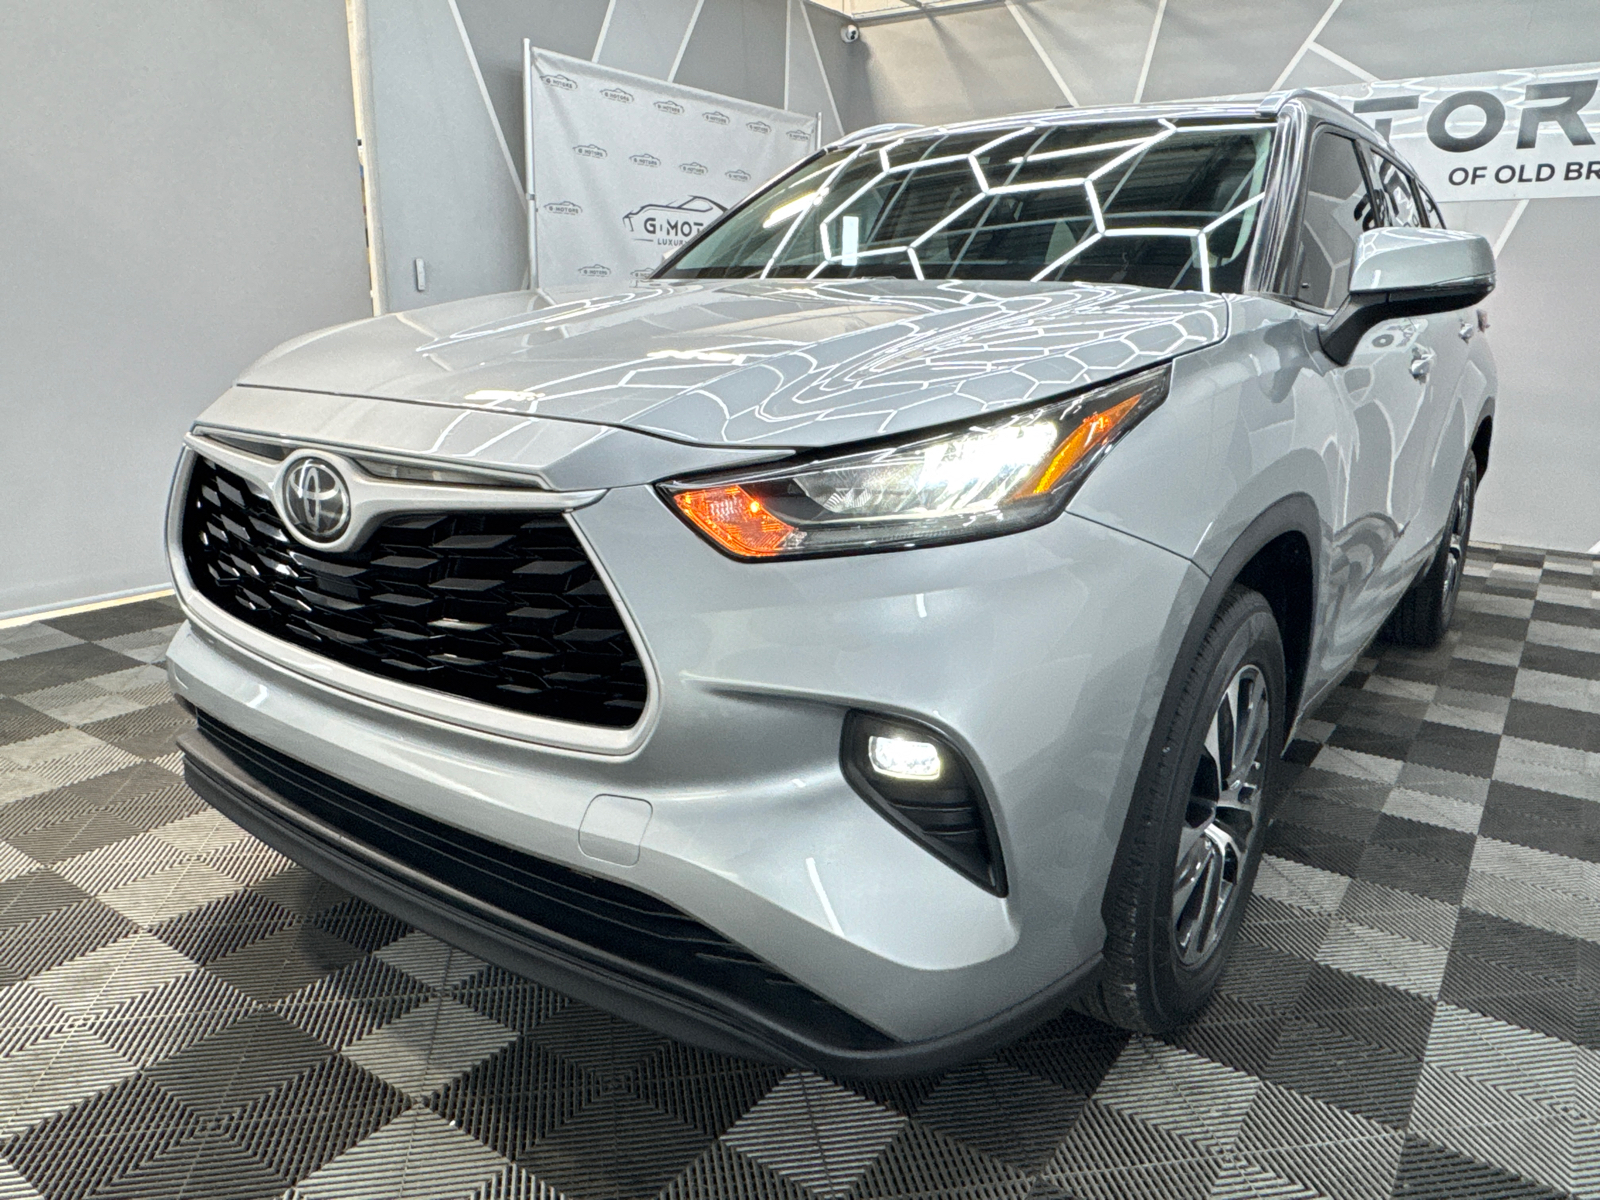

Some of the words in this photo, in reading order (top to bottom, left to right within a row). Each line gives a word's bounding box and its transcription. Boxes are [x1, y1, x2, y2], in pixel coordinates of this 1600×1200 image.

[1448, 166, 1488, 186] OF
[1494, 163, 1556, 184] OLD
[1563, 160, 1600, 181] BR
